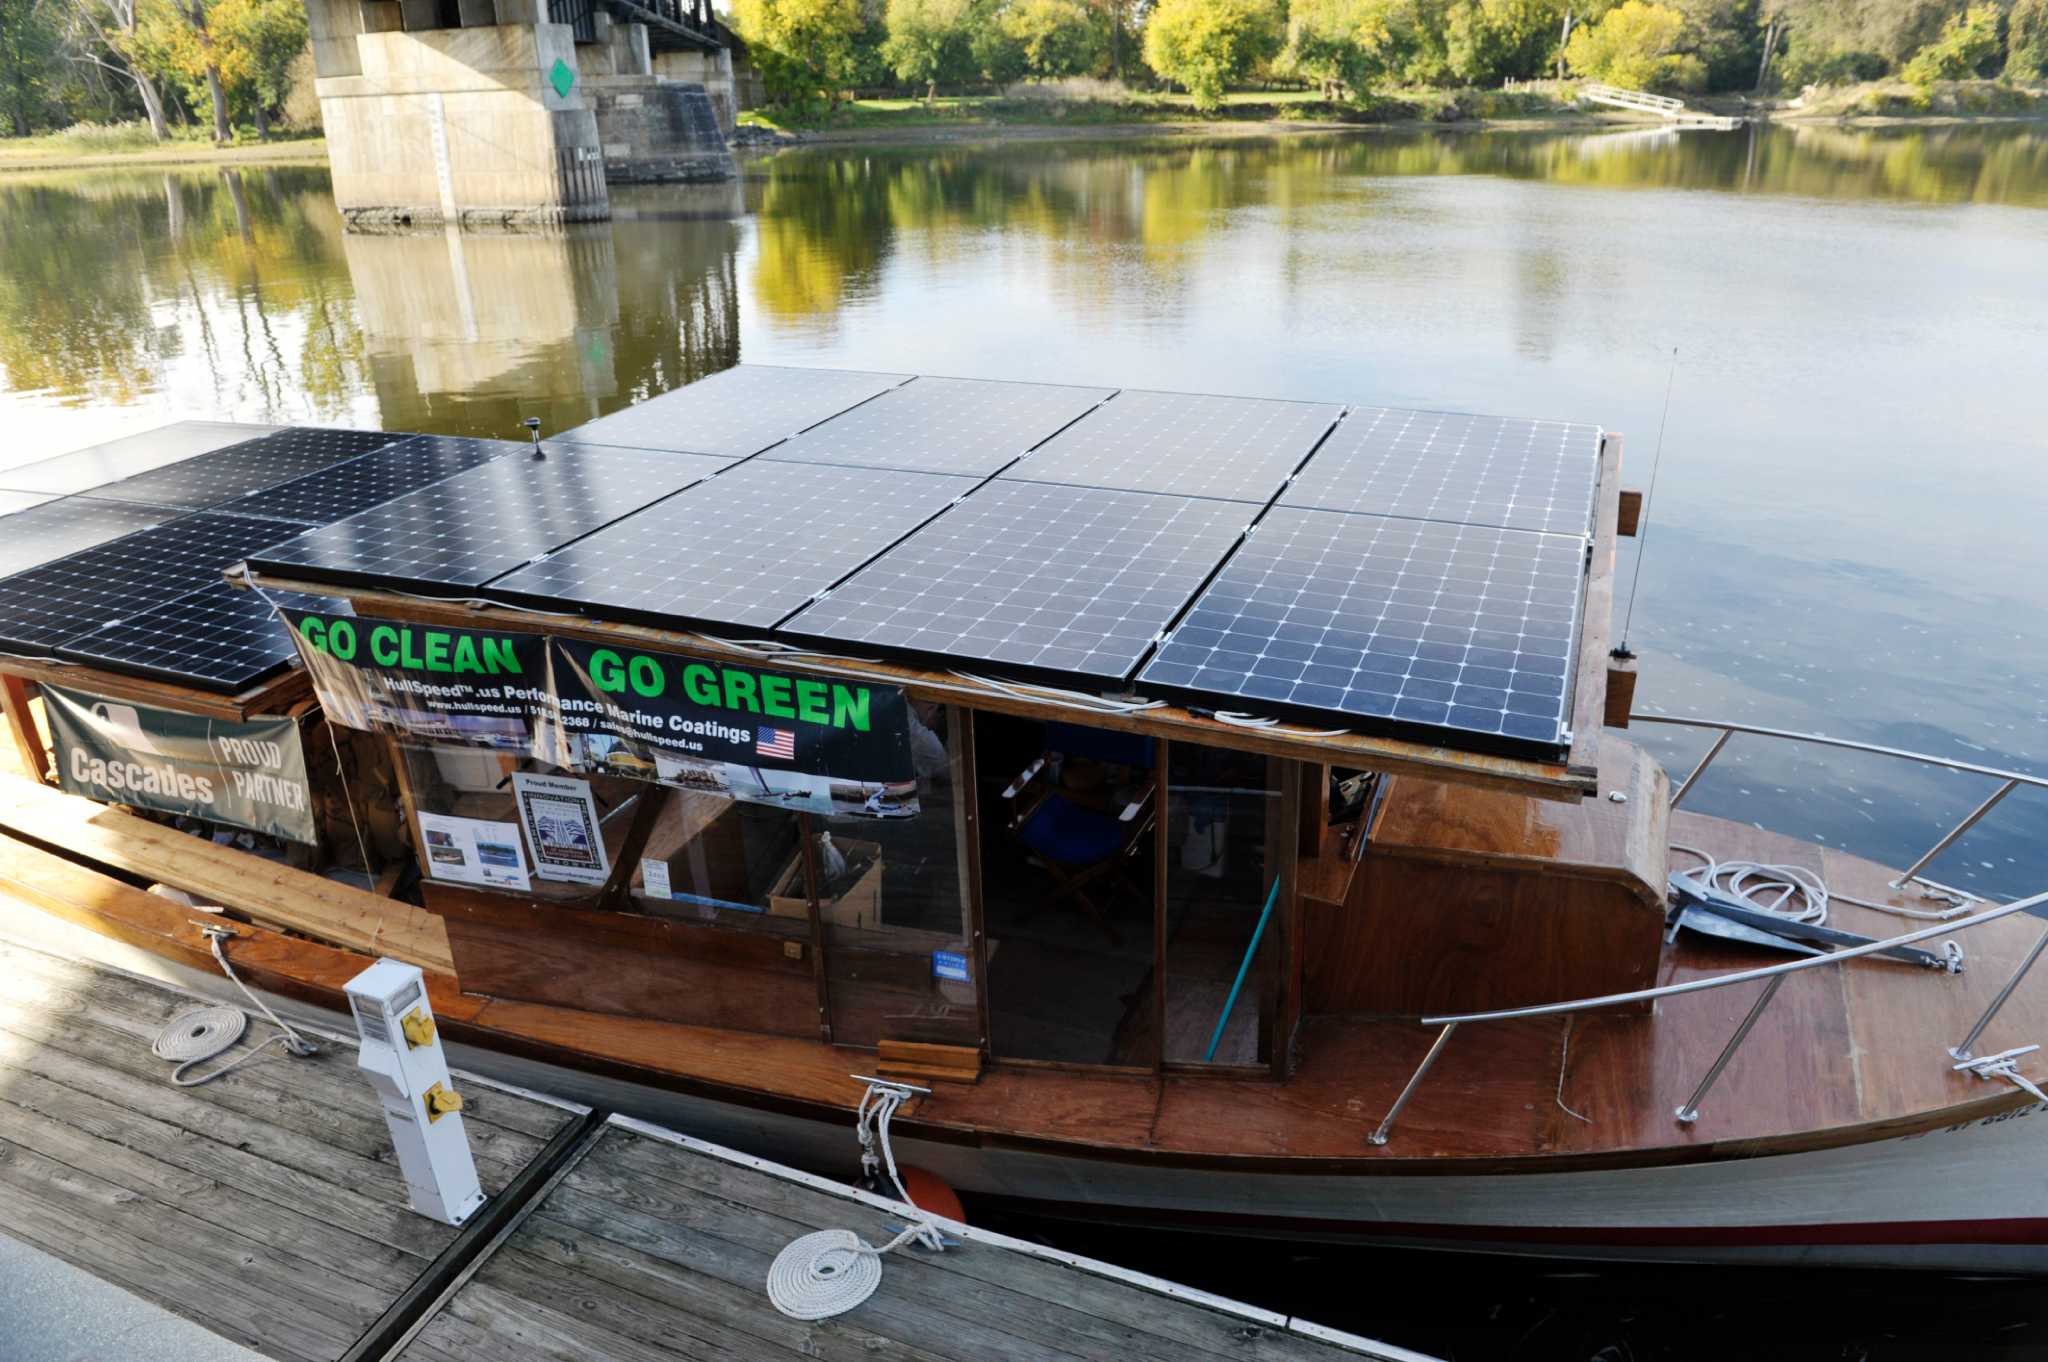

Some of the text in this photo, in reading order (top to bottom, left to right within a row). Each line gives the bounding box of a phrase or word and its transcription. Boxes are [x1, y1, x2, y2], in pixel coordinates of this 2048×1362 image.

[300, 616, 871, 732] GO CLEAN GO GREEN
[426, 700, 522, 714] www.hullspeed.us
[606, 702, 664, 728] Marine
[669, 715, 751, 744] Coatings
[218, 736, 282, 769] PROUD
[70, 747, 215, 804] Cascades
[231, 770, 305, 813] PARTNER
